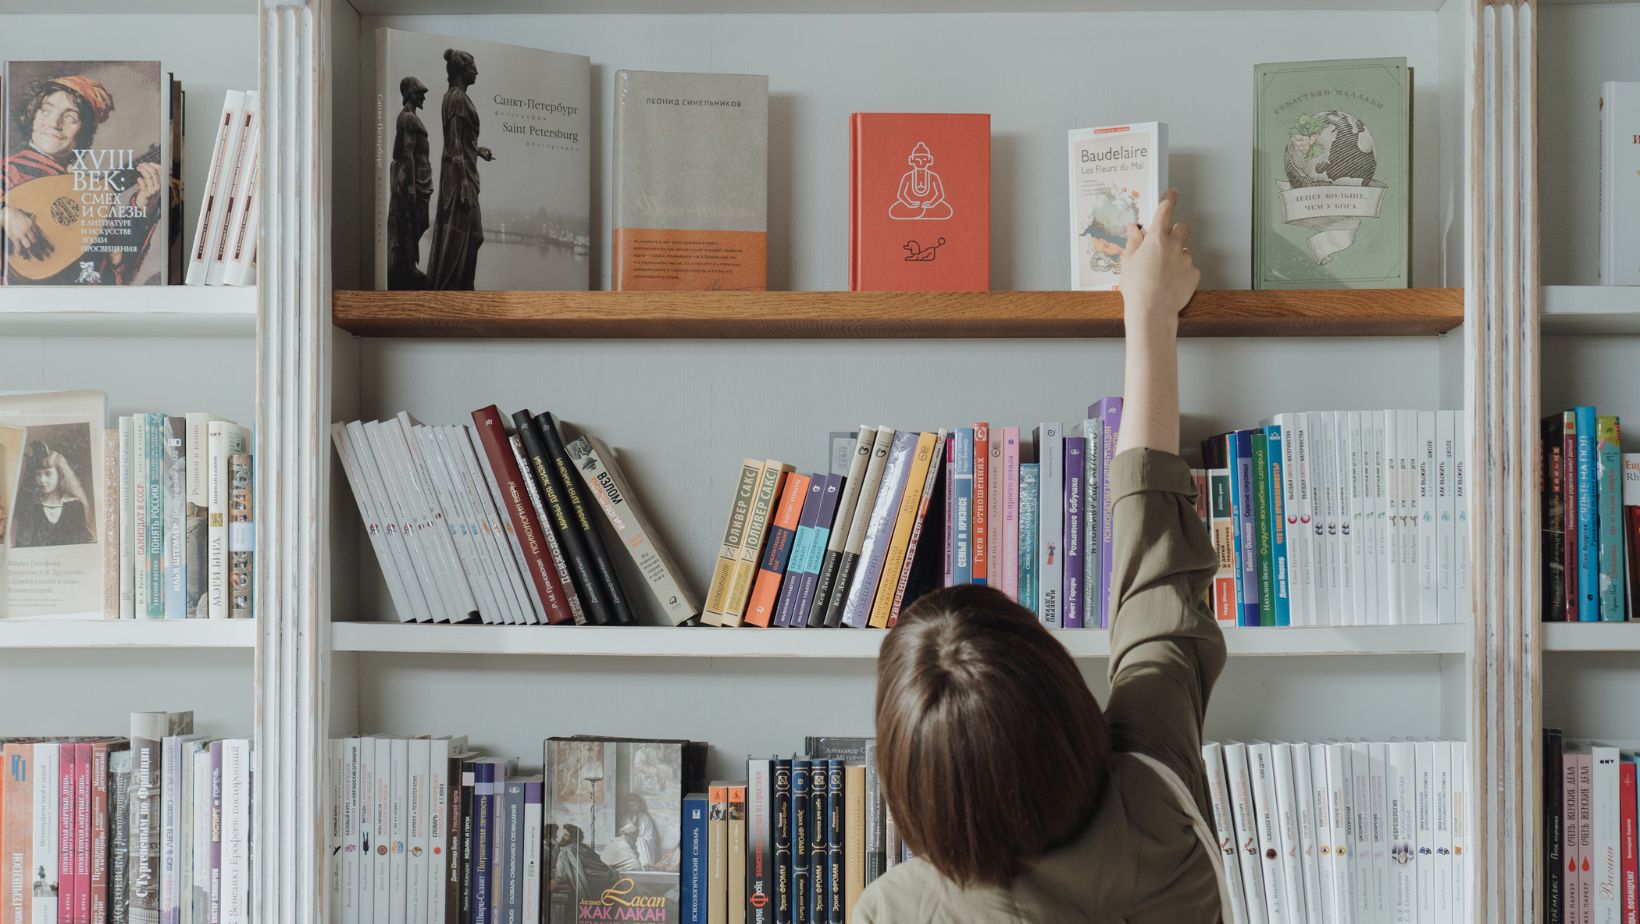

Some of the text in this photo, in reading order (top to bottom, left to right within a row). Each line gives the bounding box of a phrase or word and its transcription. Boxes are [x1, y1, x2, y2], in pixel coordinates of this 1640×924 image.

[493, 94, 579, 116] Санкт-Петербург
[646, 98, 742, 108] ЛЕОНИД СИНЕЛЬНИКОВ
[502, 122, 579, 143] Saint Petersburg
[72, 150, 134, 170] XVIII
[1081, 146, 1148, 163] Baudelaire
[1081, 161, 1144, 175] Les Fleurs du Mal
[72, 171, 125, 191] ВЕК:
[81, 193, 121, 204] СМЕХ
[82, 206, 147, 218] И СЛЕЗЫ
[1257, 450, 1265, 479] историй
[1580, 436, 1588, 480] НА ПОЛ
[151, 485, 160, 518] РОССИЮ
[534, 456, 568, 530] МИФЫ ДЛЯ ЖИЗНИ
[556, 457, 591, 531] МИФЫ ДЛЯ ЖИЗНИ
[597, 471, 623, 505] ВЗЛОМ
[728, 470, 757, 543] ОЛИВЕР САКС
[750, 470, 778, 545] ОЛИВЕР САКС
[507, 481, 540, 555] ПСИХОЛОГИЯ ВЕРЫ
[958, 497, 967, 530] КРИЗИСЕ
[1007, 511, 1014, 521] Не
[1089, 481, 1098, 546] ПОЖИВУ ЕЩЕ
[1104, 490, 1112, 543] ПСИХОПАТИИ
[137, 512, 146, 555] САМИЗДАТ
[151, 520, 160, 553] ПОНЯТЬ
[172, 524, 180, 565] ШТЕМЛЕР
[975, 538, 984, 562] Гнев
[1070, 515, 1078, 556] Рождение
[211, 537, 220, 606] МЭРИ БИРД
[958, 542, 967, 567] СЕМЬЯ
[536, 559, 553, 594] Грановская
[860, 554, 881, 608] ДЕПРЕССИИ
[891, 549, 912, 619] УВЕРЕННОСТЬ
[1069, 577, 1077, 619] Анат Гарари
[98, 752, 106, 792] Достоевский
[1567, 766, 1575, 784] ДЕЛА
[797, 809, 805, 826] Эрих
[1258, 753, 1273, 843] ПСИХОЛОГИЯ ПОВЕДЕНИЯ
[1581, 766, 1589, 846] ОЧЕНЬ ЖЕНСКИЕ ДЕЛА
[136, 748, 153, 897] С Тургеневым во Франции
[212, 808, 220, 841] ВОСТОРГ
[229, 746, 241, 916] Венедикт посторонний
[93, 838, 101, 881] Провидение
[113, 776, 125, 922] ДОСТОЕВСКАЯ Воспоминания
[477, 829, 487, 872] Пограничная
[1551, 844, 1559, 859] Плод
[12, 852, 23, 906] ГЕРШЕНЗОН
[779, 865, 787, 893] ФРОММ
[1599, 846, 1616, 900] Вагина
[1627, 871, 1635, 909] ПОТАНЦУЕМ?
[476, 875, 486, 924] Шварц-Салант
[601, 878, 666, 908] Lacan
[579, 906, 666, 921] ЖАК ЛАКАН
